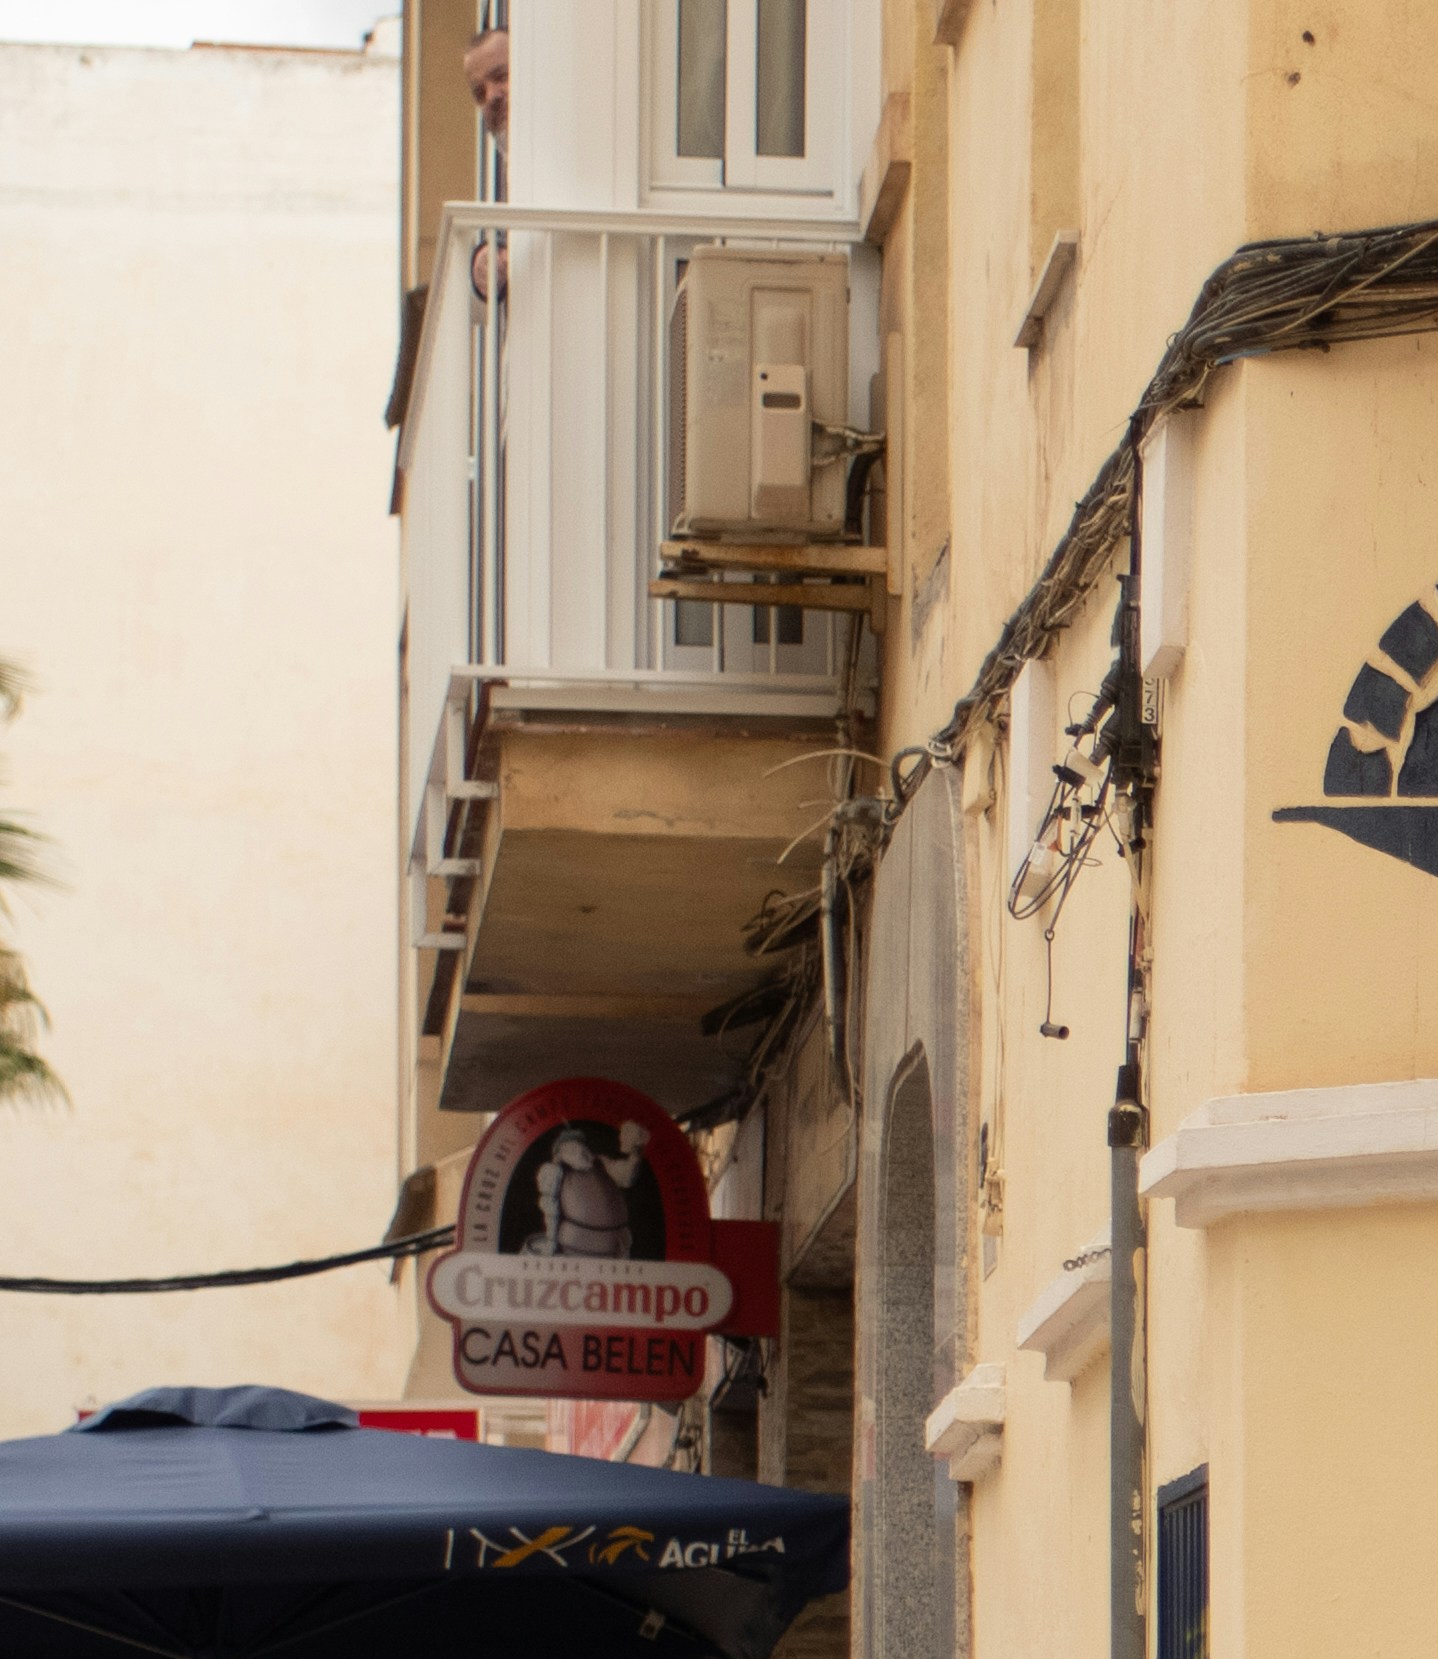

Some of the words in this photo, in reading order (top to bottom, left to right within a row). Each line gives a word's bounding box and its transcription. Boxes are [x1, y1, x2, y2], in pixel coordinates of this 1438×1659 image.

[454, 1262, 710, 1323] Cruzcampo
[461, 1327, 567, 1371] CASA
[582, 1334, 696, 1377] BELEN
[728, 1528, 749, 1545] EL
